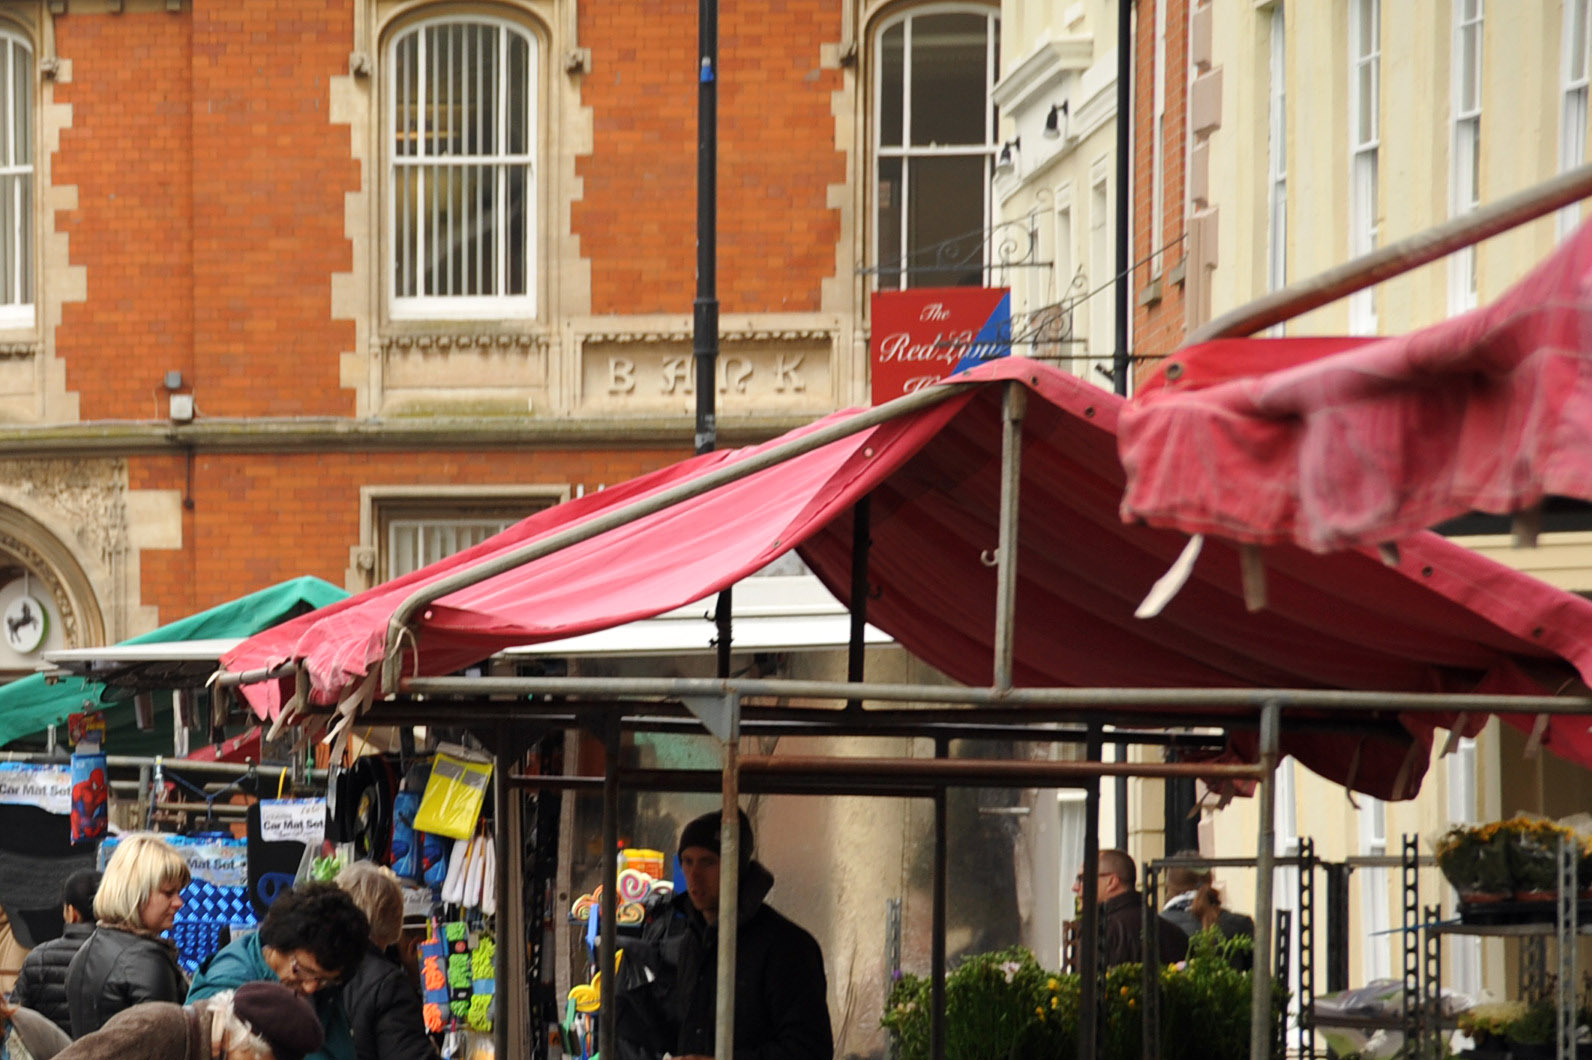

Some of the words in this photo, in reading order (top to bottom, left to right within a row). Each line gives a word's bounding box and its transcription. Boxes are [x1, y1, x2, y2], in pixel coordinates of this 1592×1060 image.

[919, 302, 950, 321] The
[879, 332, 943, 363] Red
[607, 353, 807, 396] BANK
[22, 785, 47, 796] Mat
[51, 785, 71, 797] Set
[263, 820, 281, 831] Car
[283, 820, 304, 831] Mat
[306, 819, 324, 830] Set
[213, 859, 235, 870] Set
